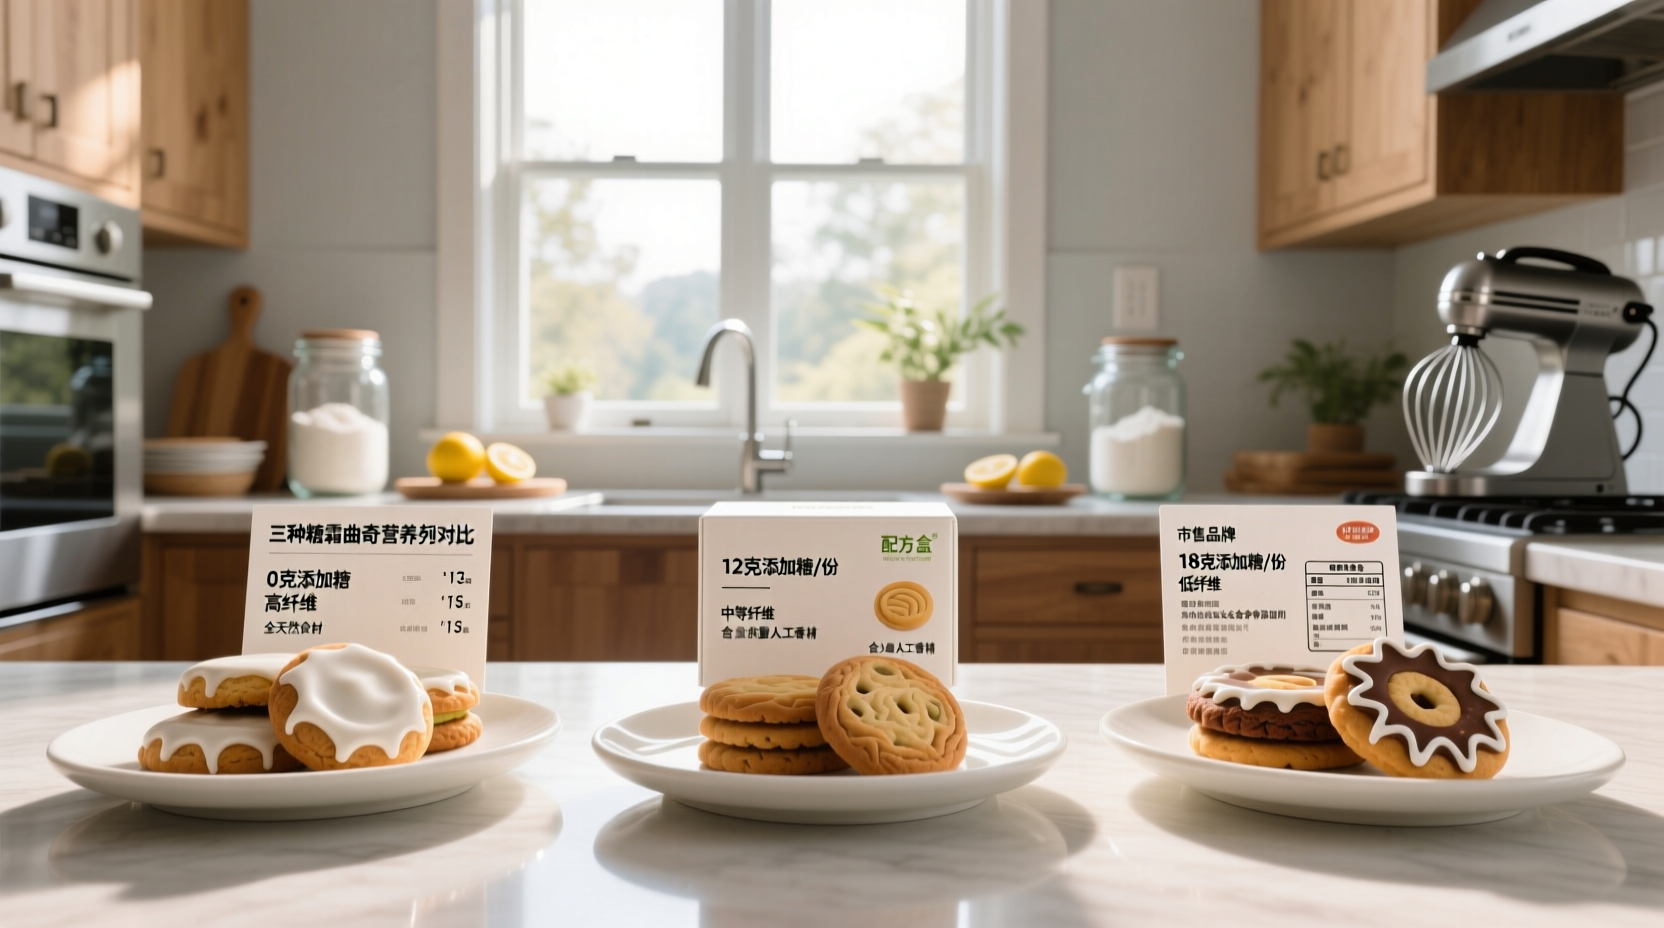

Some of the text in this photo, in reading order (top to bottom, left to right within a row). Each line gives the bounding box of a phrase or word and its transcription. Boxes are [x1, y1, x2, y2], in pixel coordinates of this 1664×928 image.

[881, 535, 933, 553] 配方盒
[1177, 526, 1237, 543] 市售品牌
[722, 556, 838, 577] 12克添加糖/份
[1179, 552, 1286, 572] 18克添加糖/份
[267, 569, 351, 589] 0克添加糖
[265, 593, 317, 613] 高纤维
[721, 605, 775, 621] 中等纤维
